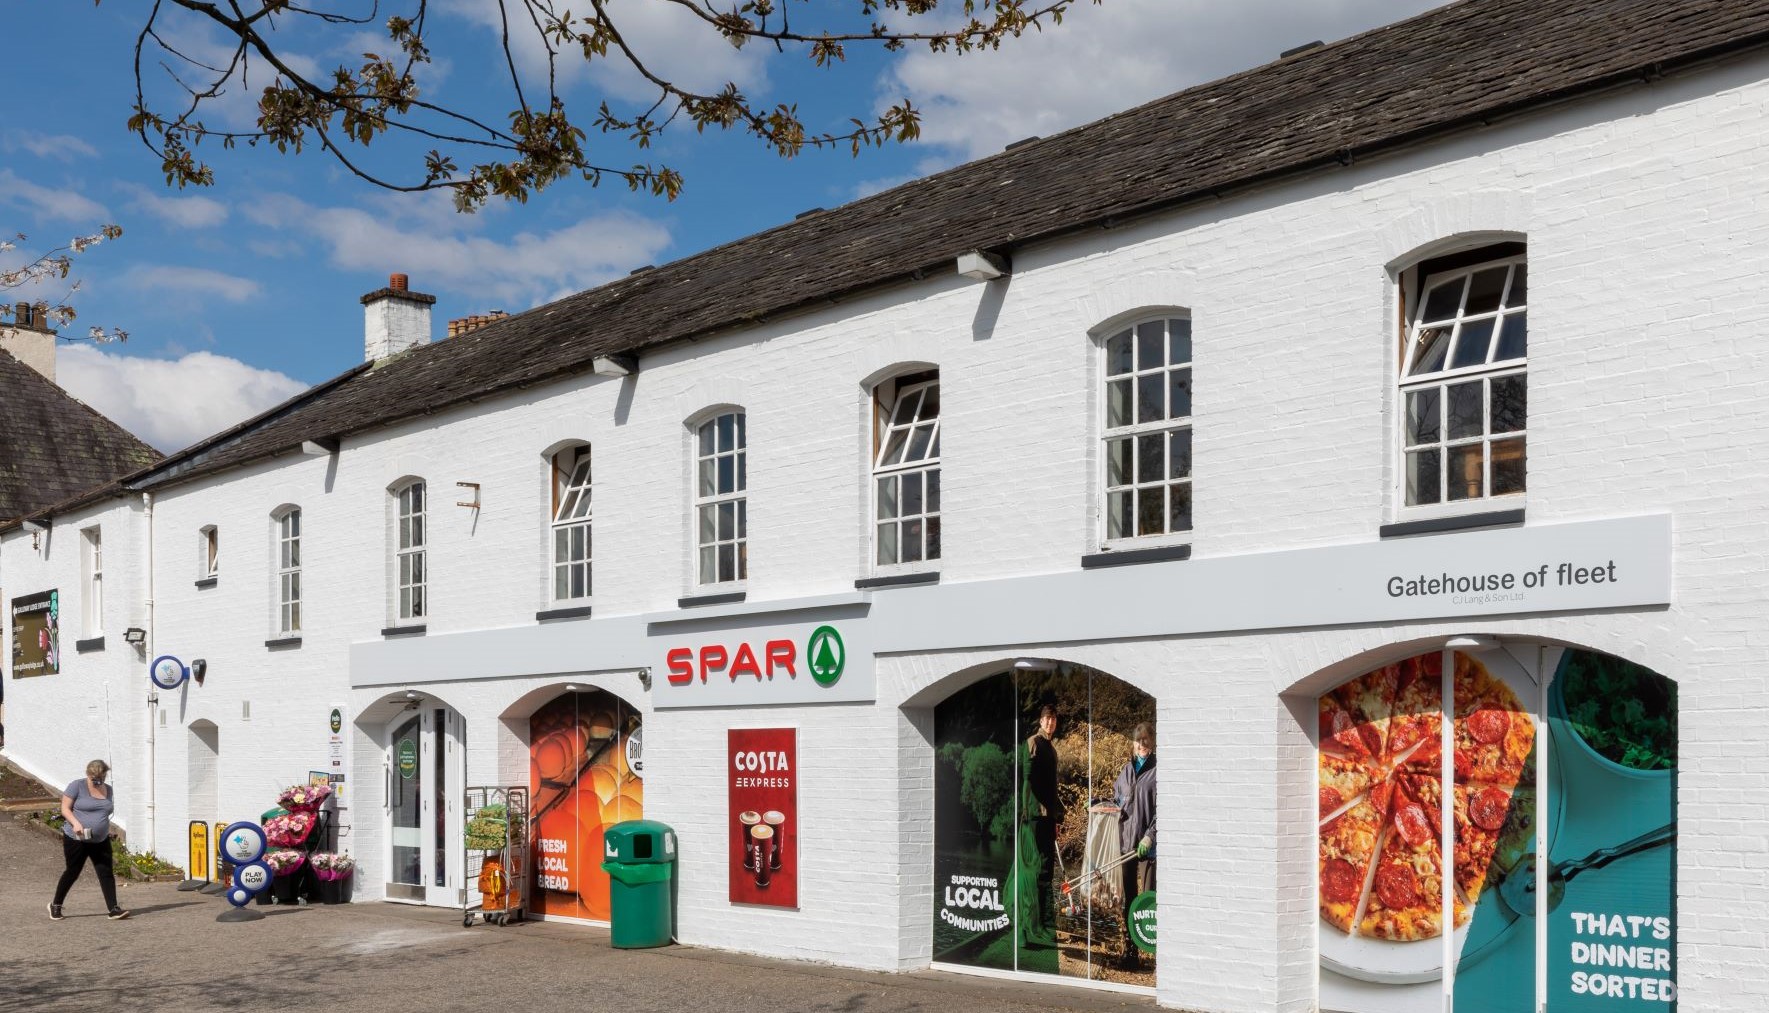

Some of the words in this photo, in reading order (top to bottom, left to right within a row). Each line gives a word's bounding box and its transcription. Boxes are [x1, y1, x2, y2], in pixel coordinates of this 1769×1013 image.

[1387, 573, 1515, 598] Gatehouse
[1522, 565, 1549, 588] of
[1556, 560, 1618, 587] fleet
[1464, 595, 1484, 605] Lang
[1485, 593, 1491, 602] &
[1492, 593, 1509, 602] Son
[667, 640, 796, 685] SPAR
[629, 740, 642, 759] BRO
[735, 751, 789, 774] COSTA
[743, 777, 789, 788] EXPRESS
[537, 838, 568, 854] FRESH
[537, 856, 569, 872] LOCAL
[537, 874, 569, 890] BREAD
[951, 875, 998, 888] SUPPORTING
[945, 886, 1005, 911] LOCAL
[940, 908, 1010, 932] COMMUNITIES
[1570, 912, 1671, 940] THAT'S
[1571, 941, 1671, 971] DINNER
[1570, 971, 1678, 1002] SORTED
